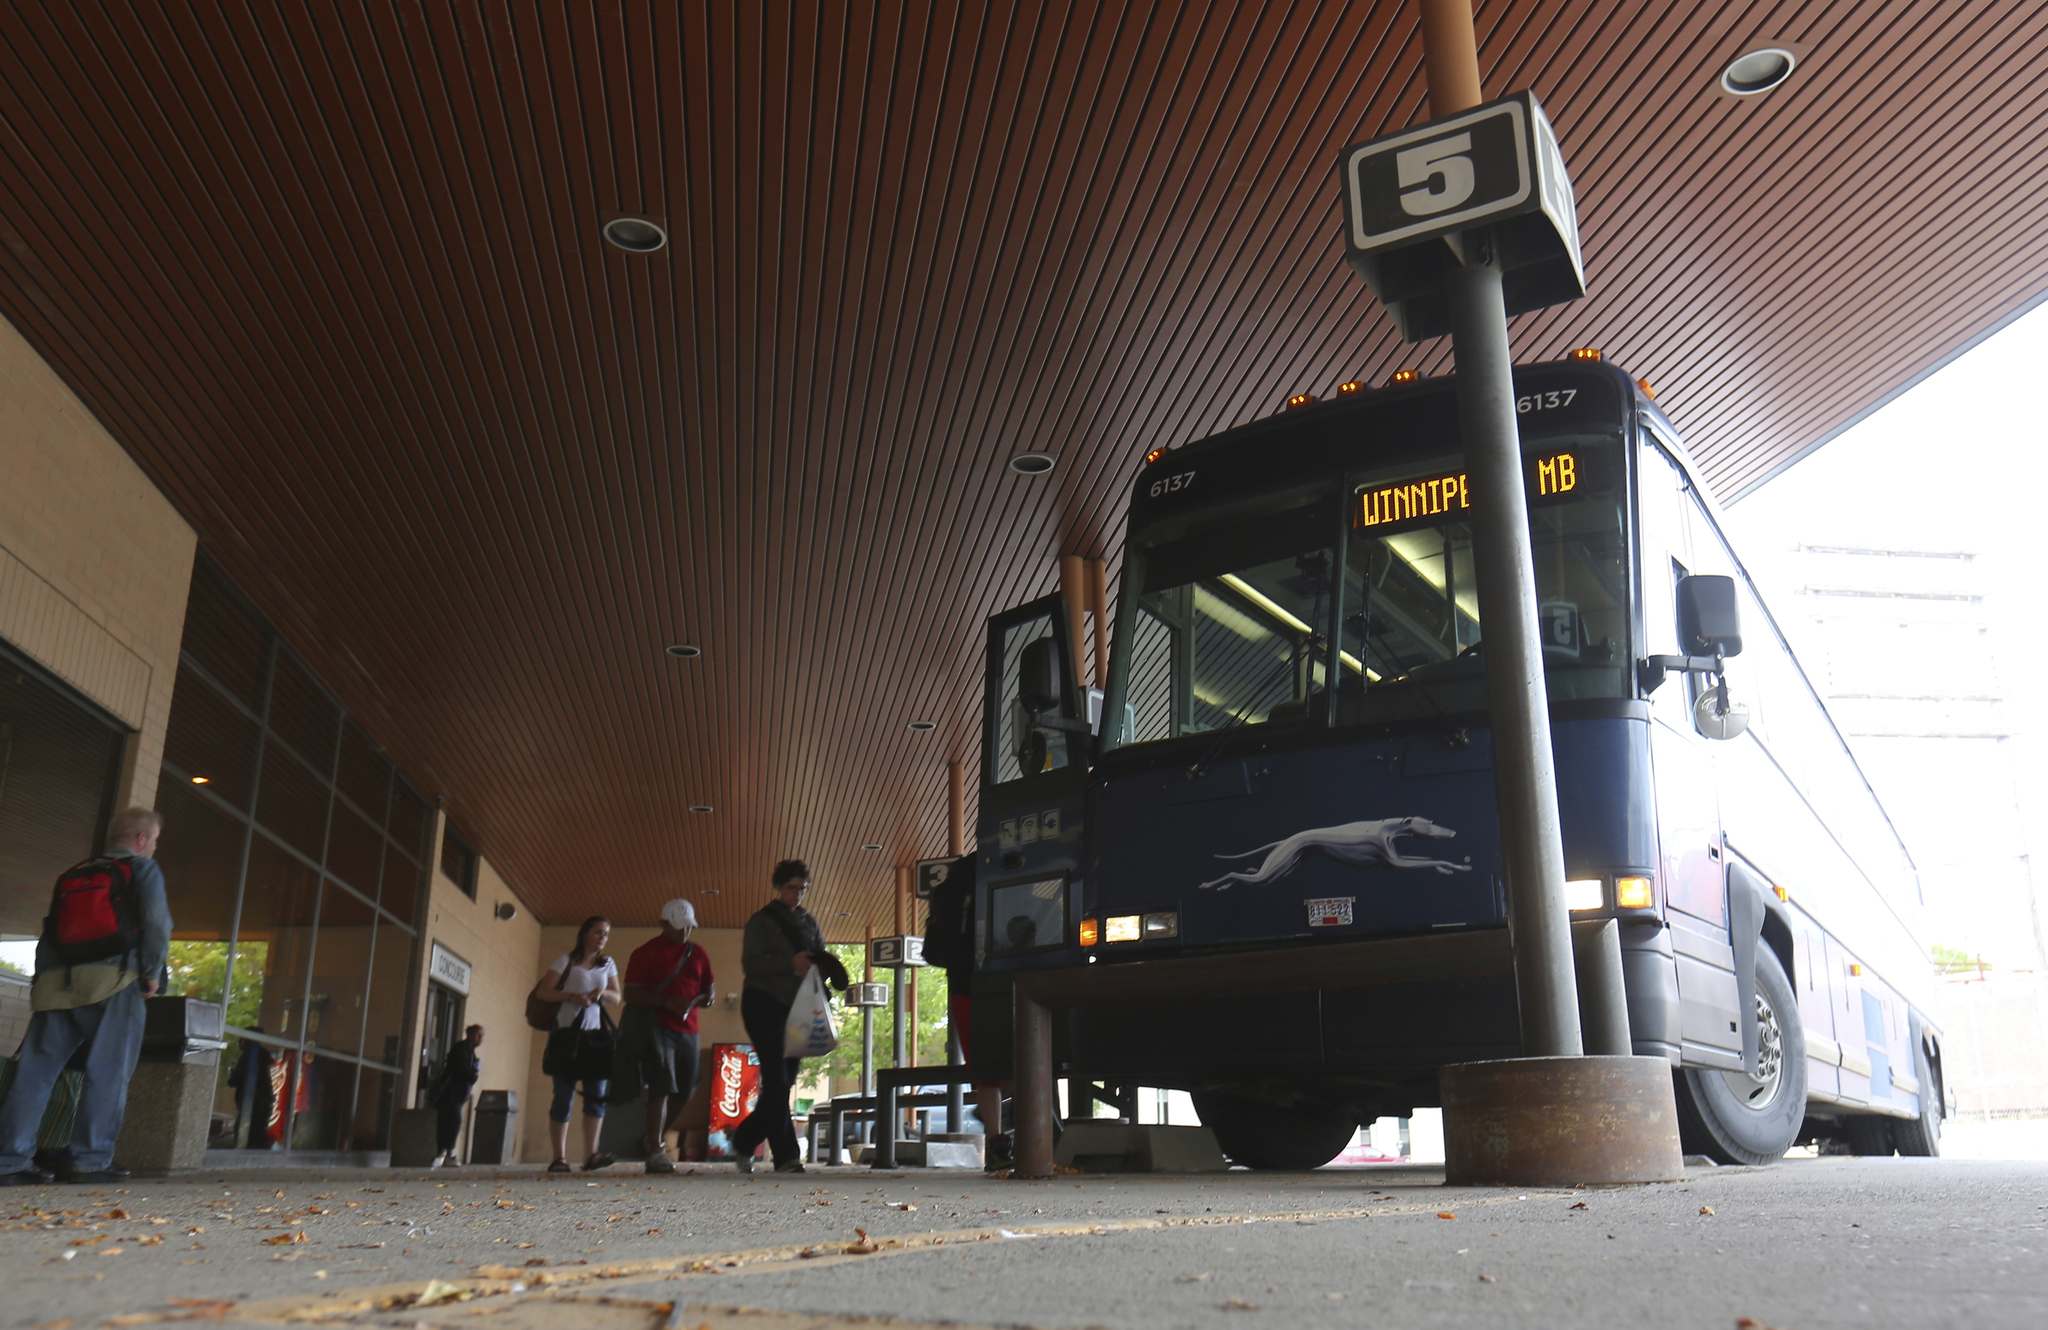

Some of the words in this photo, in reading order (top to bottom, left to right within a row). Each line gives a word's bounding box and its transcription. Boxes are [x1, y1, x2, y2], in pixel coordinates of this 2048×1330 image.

[1396, 131, 1475, 216] 5
[1516, 389, 1577, 414] 6137
[1150, 470, 1196, 498] 6137
[1363, 474, 1470, 526] WINNIPE
[1538, 453, 1576, 495] MB
[928, 864, 949, 887] 3
[879, 942, 895, 960] 2
[871, 987, 880, 1000] 1
